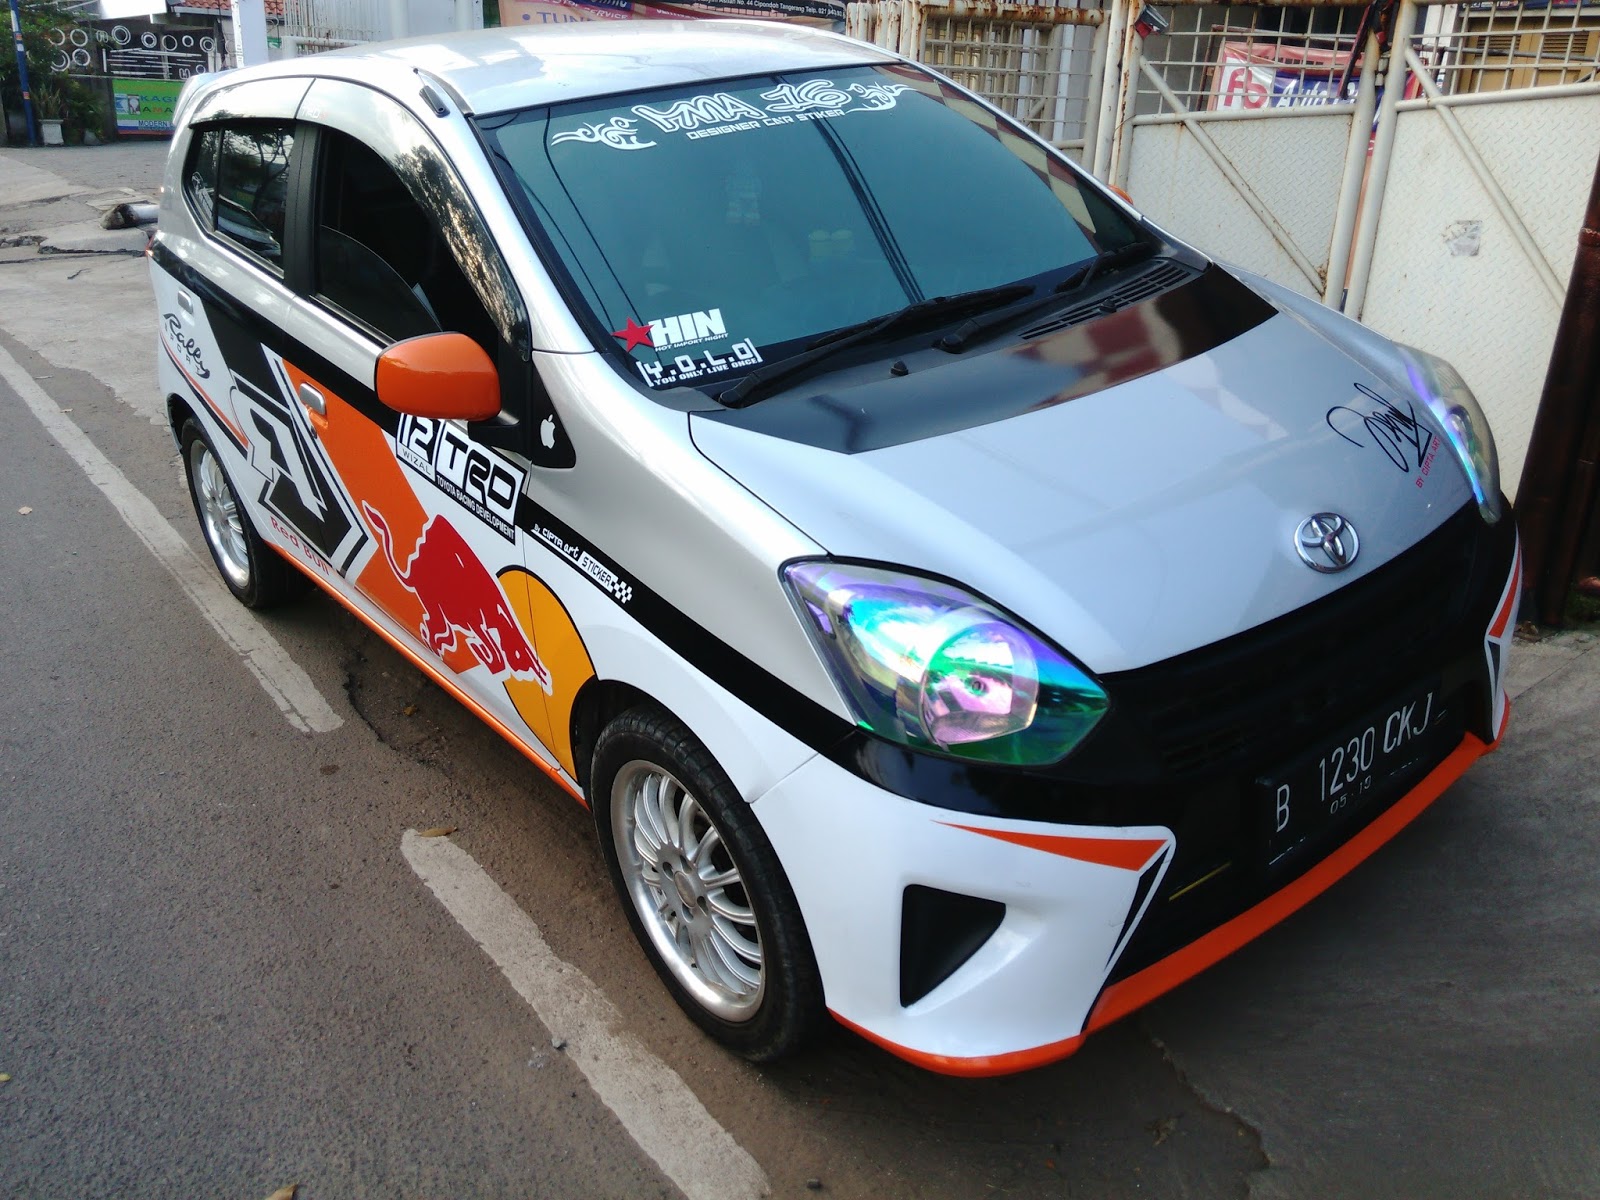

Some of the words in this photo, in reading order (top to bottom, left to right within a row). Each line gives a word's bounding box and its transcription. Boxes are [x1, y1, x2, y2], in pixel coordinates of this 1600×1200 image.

[780, 2, 805, 14] Tangerang
[686, 120, 761, 140] DESIGNER
[796, 109, 845, 121] STIKER
[648, 308, 727, 348] HIN
[654, 342, 673, 353] HOT
[673, 337, 703, 349] IMPORT
[704, 332, 729, 343] NIGHT
[653, 375, 677, 386] YOU
[679, 369, 704, 380] ONLY
[706, 363, 729, 374] LIVE
[731, 357, 758, 368] ONCE
[402, 448, 432, 477] WIZAL
[444, 430, 517, 510] TRD
[1415, 476, 1424, 488] BY
[1431, 435, 1441, 452] ART
[436, 474, 456, 497] TOYOTA
[455, 488, 476, 512] RACING
[475, 503, 515, 540] DEVELOPMENT
[270, 515, 300, 549] Red
[303, 543, 329, 576] Bull
[542, 527, 563, 549] CIPTA
[563, 543, 580, 558] art
[581, 556, 612, 587] STICKER
[1276, 783, 1290, 833] B
[1319, 726, 1375, 802] 1230
[1383, 692, 1433, 753] CKJ
